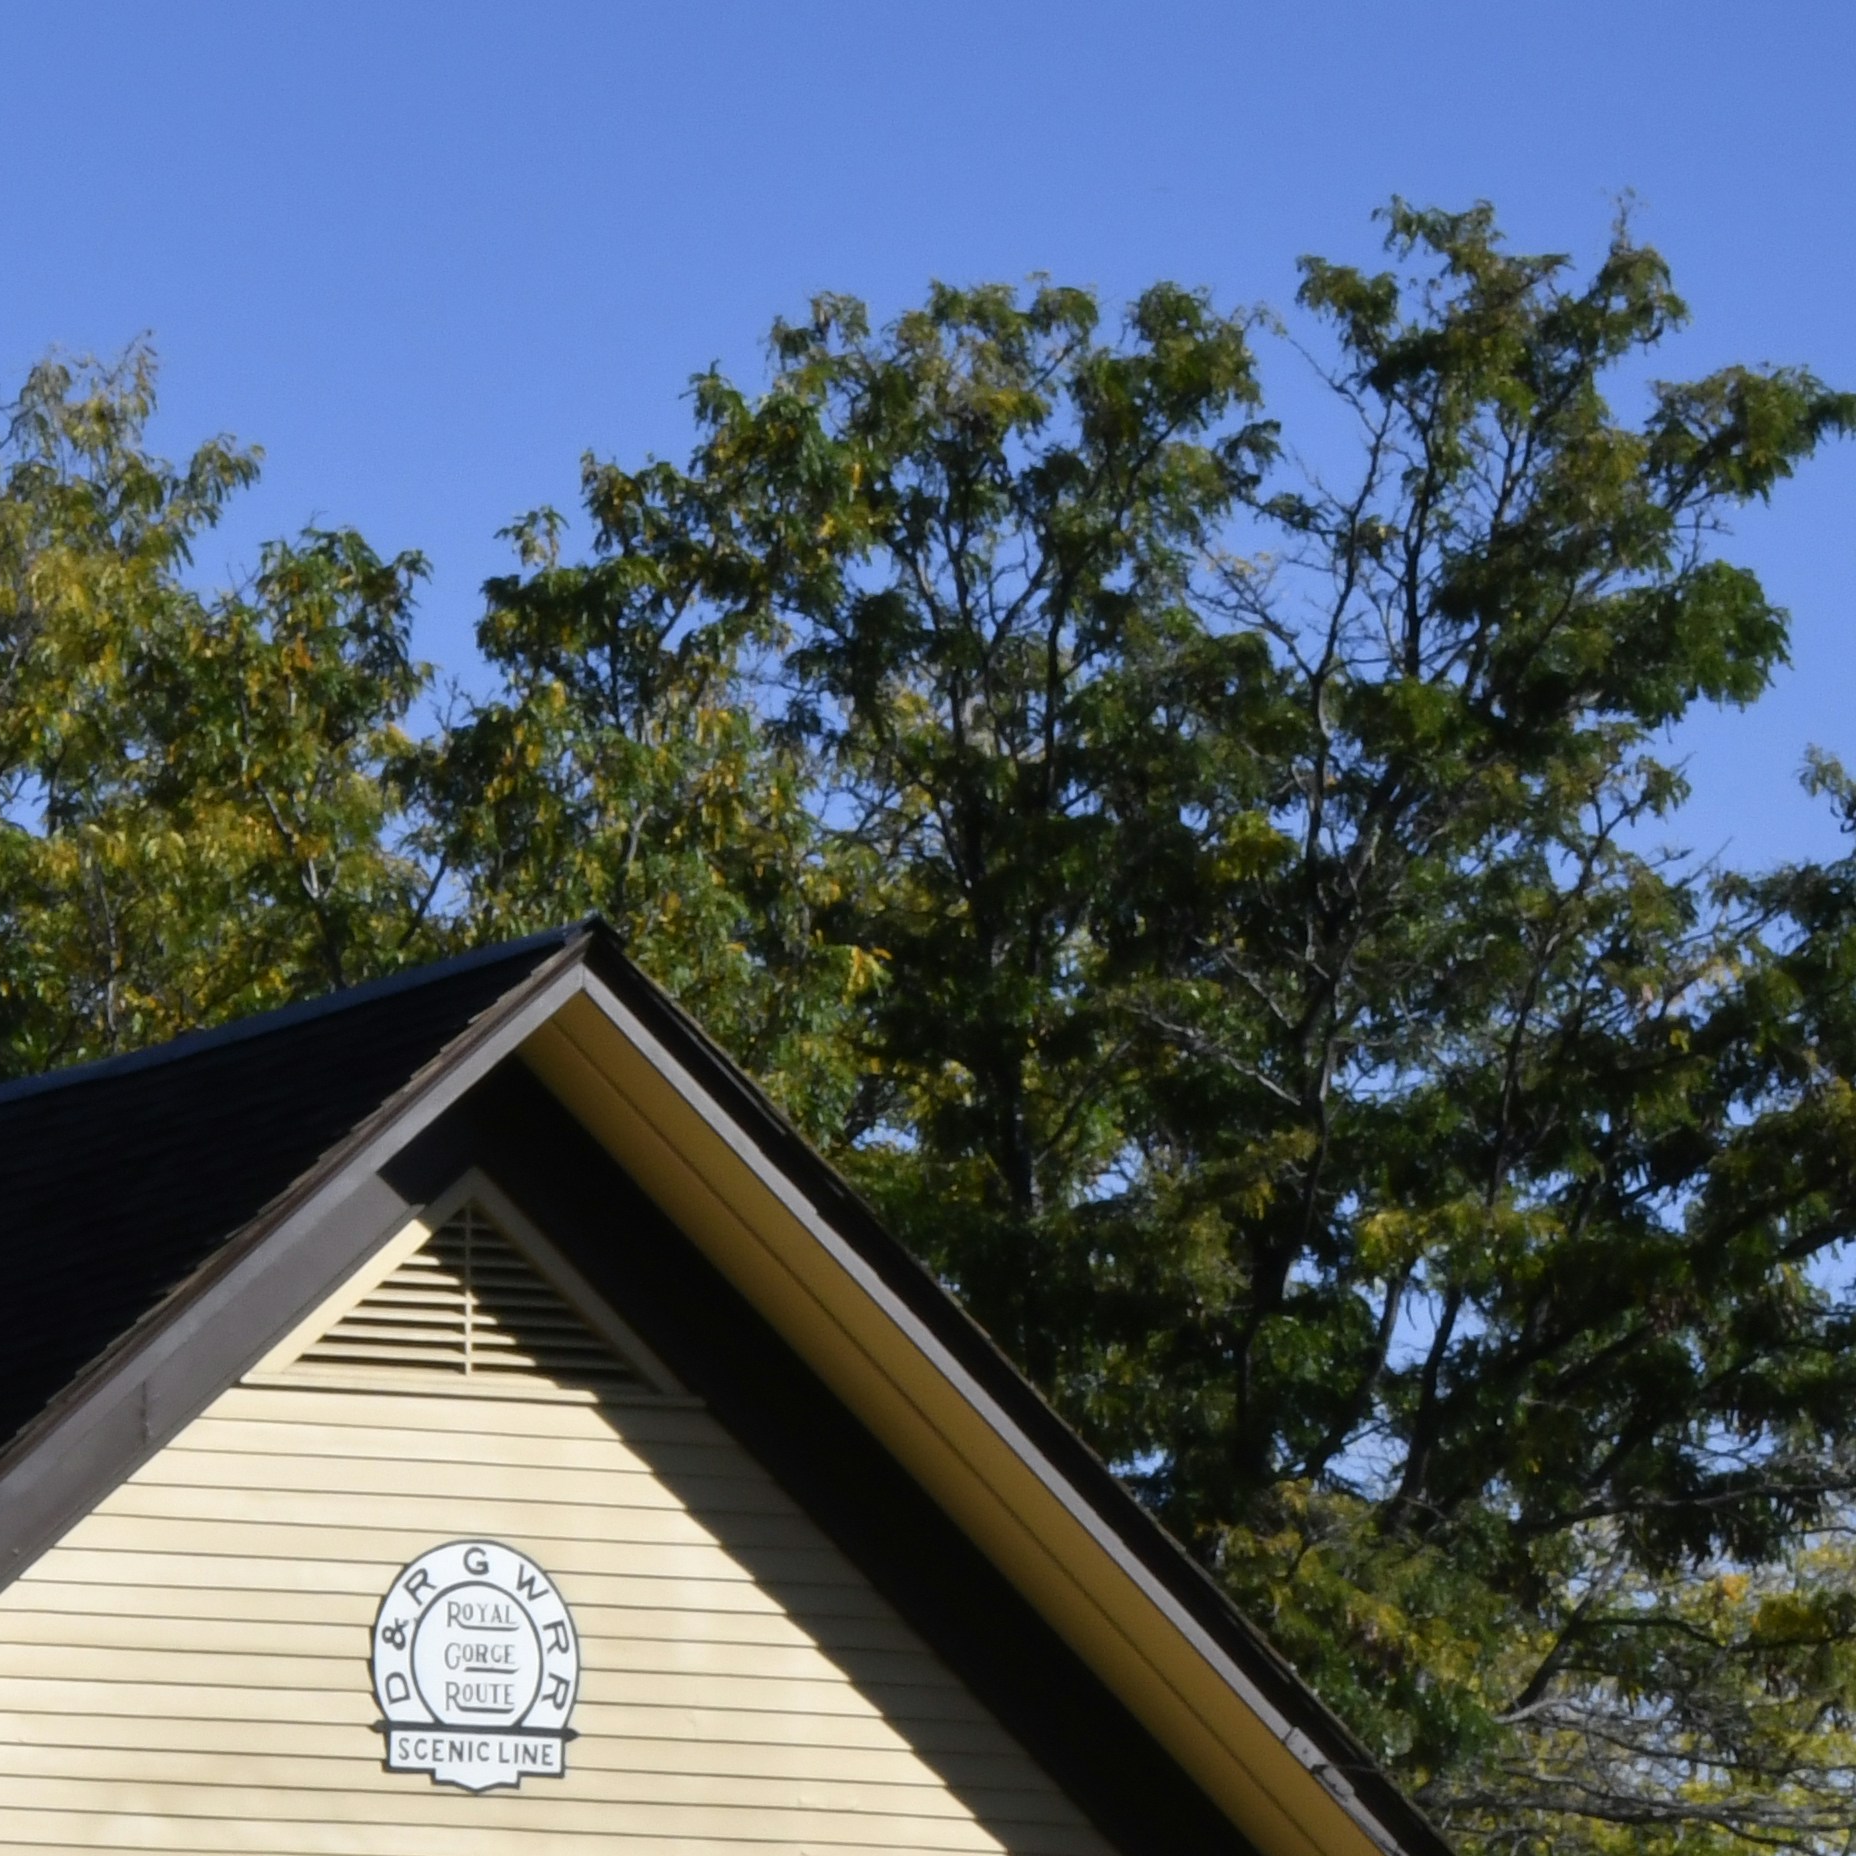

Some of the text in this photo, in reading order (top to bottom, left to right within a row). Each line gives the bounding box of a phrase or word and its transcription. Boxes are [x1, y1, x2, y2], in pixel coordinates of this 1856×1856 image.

[447, 1601, 519, 1631] ROYAL
[444, 1642, 518, 1672] GORGE
[445, 1681, 515, 1713] ROUTE
[398, 1738, 553, 1765] SCENIC LINE
